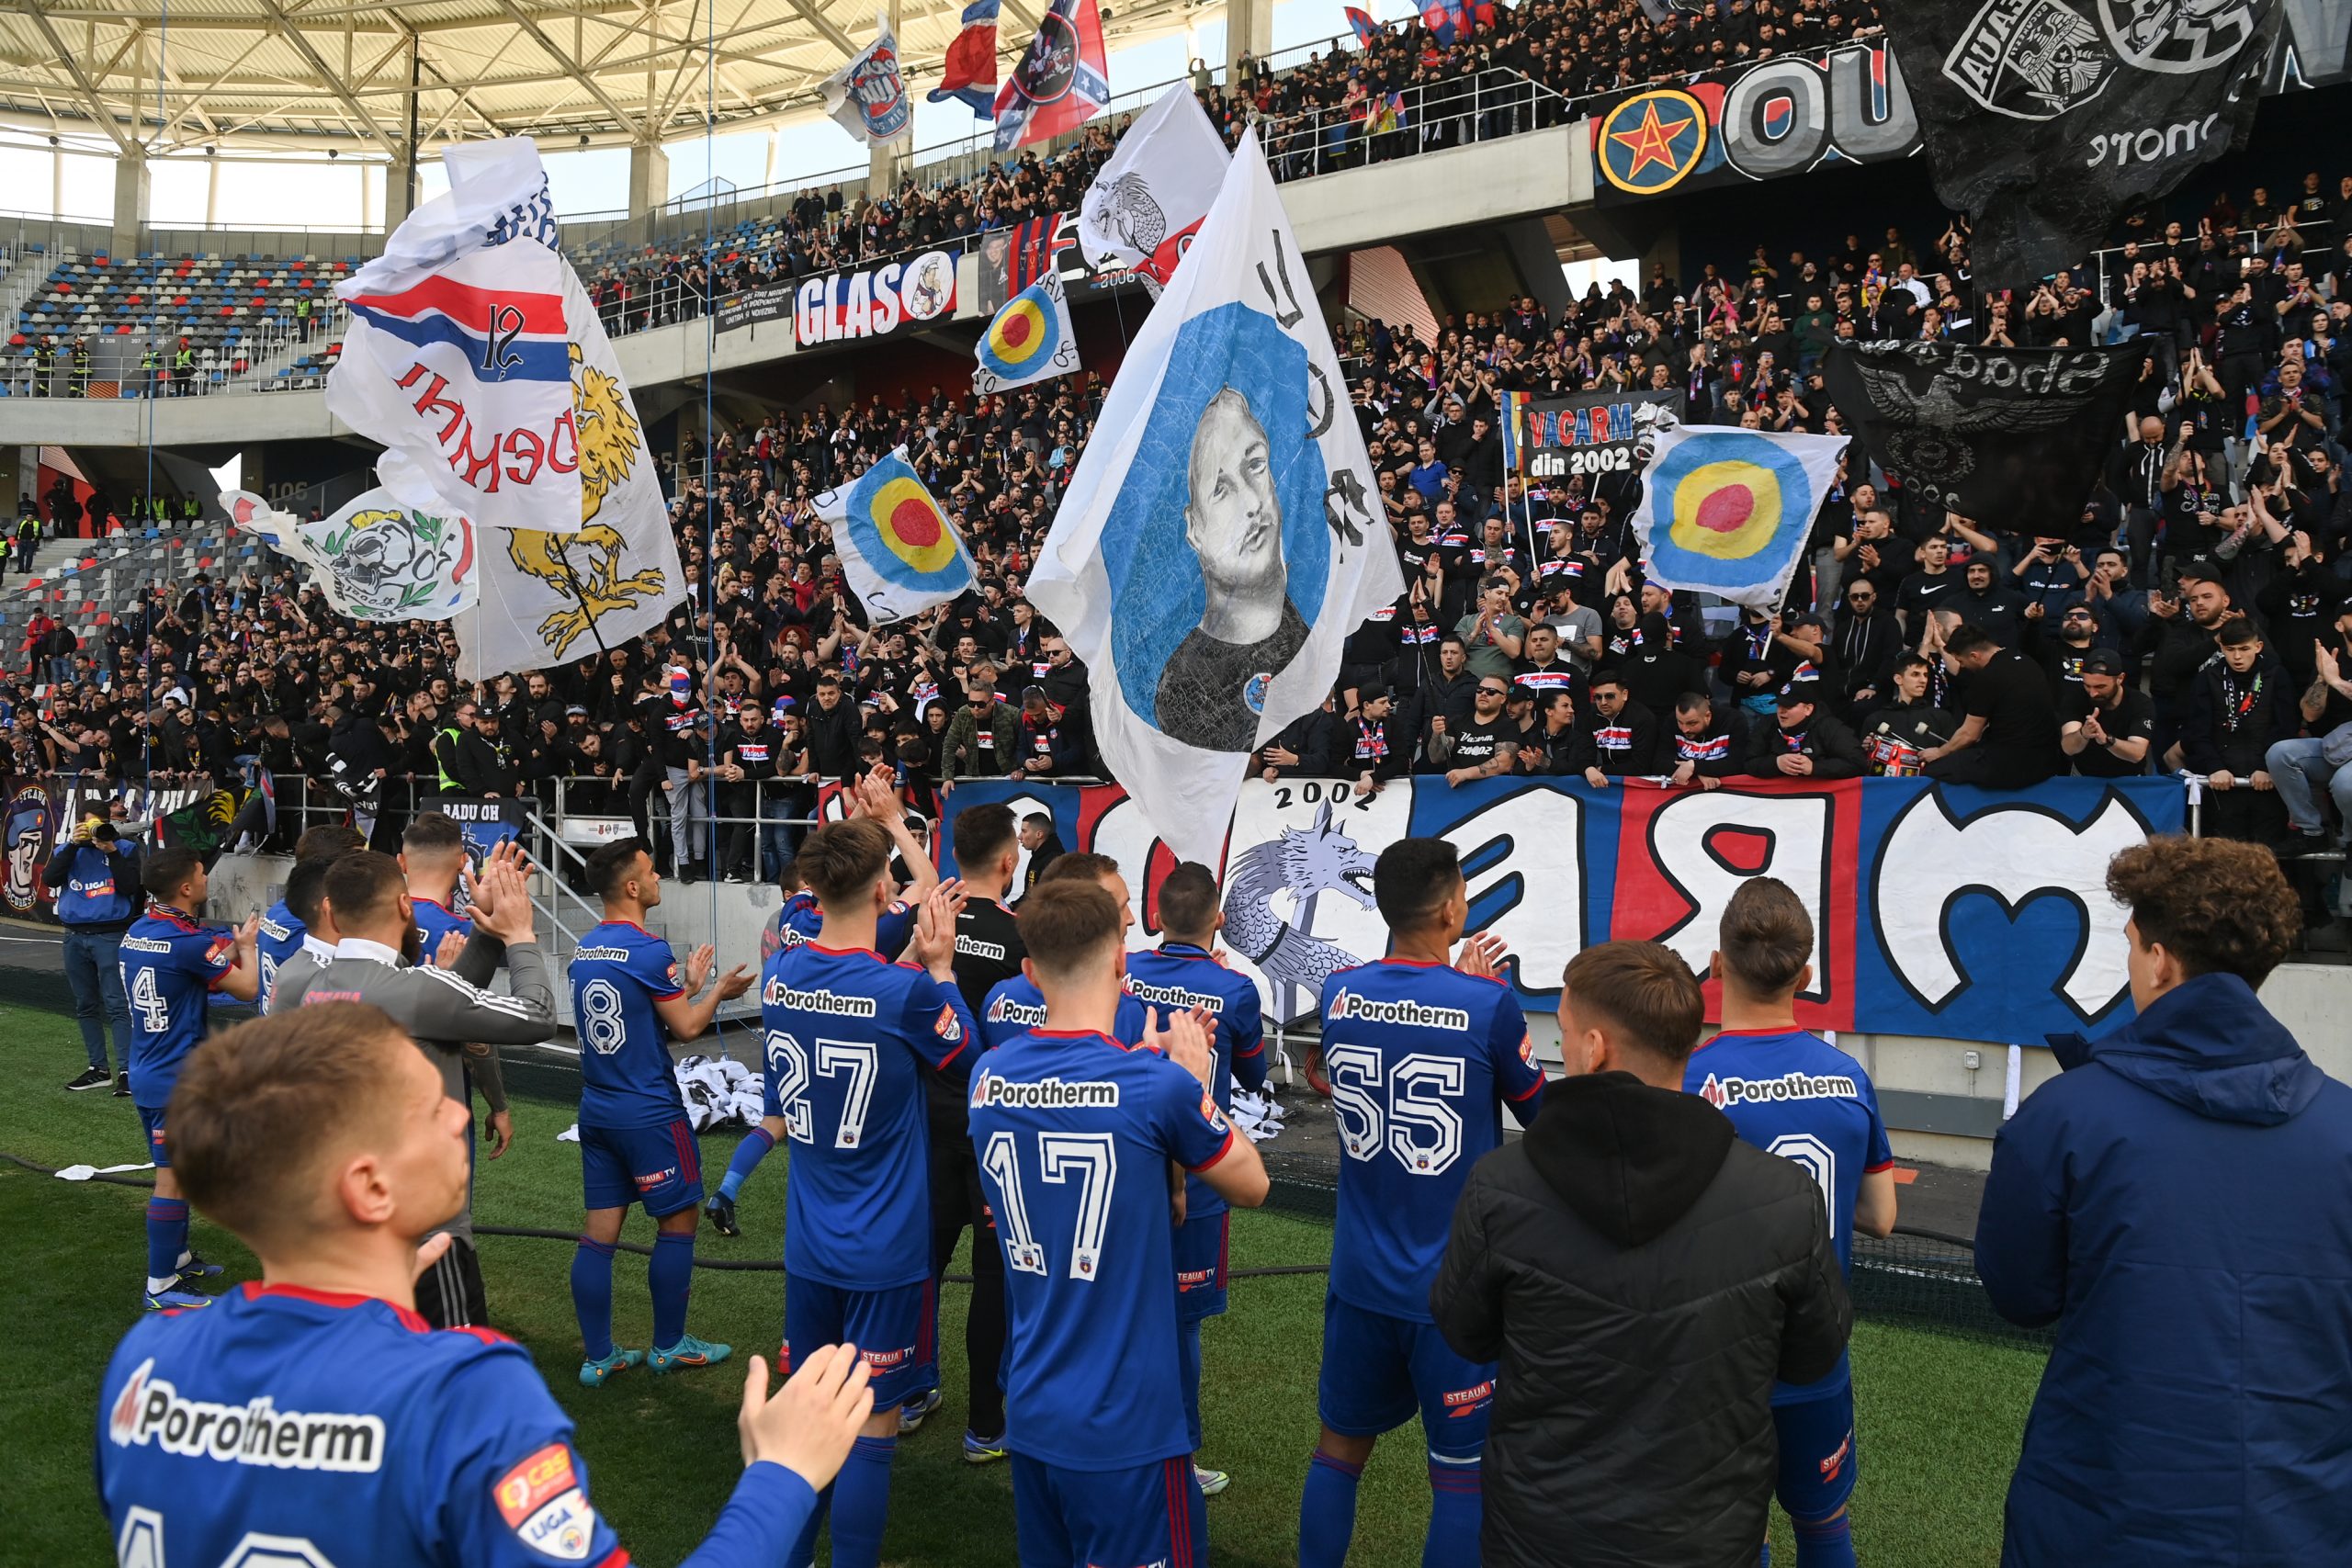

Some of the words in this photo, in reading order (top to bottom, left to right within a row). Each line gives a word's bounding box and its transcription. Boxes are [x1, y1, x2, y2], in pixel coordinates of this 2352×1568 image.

[1100, 268, 1136, 288] 2006
[1529, 403, 1634, 448] VACARM
[1531, 452, 1566, 477] din
[1570, 446, 1631, 474] 2002
[267, 480, 309, 502] 106
[1273, 781, 1378, 812] 2002
[85, 881, 106, 891] LIGA
[122, 936, 169, 953] Porotherm
[575, 946, 628, 961] Porotherm
[956, 937, 1005, 960] therm
[775, 985, 874, 1015] Porotherm
[1131, 981, 1222, 1011] Porotherm
[1347, 996, 1466, 1029] Porotherm
[766, 1029, 879, 1149] 27
[988, 1077, 1115, 1104] Porotherm
[1725, 1075, 1855, 1102] Porotherm
[1326, 1043, 1466, 1176] 55
[663, 1167, 676, 1177] TV
[981, 1131, 1117, 1282] 17
[1205, 1266, 1216, 1279] TV
[863, 1351, 900, 1363] STEAUA
[903, 1345, 916, 1359] TV
[1447, 1387, 1487, 1404] STEAUA
[140, 1388, 375, 1463] Porotherm
[530, 1507, 573, 1540] LIGA
